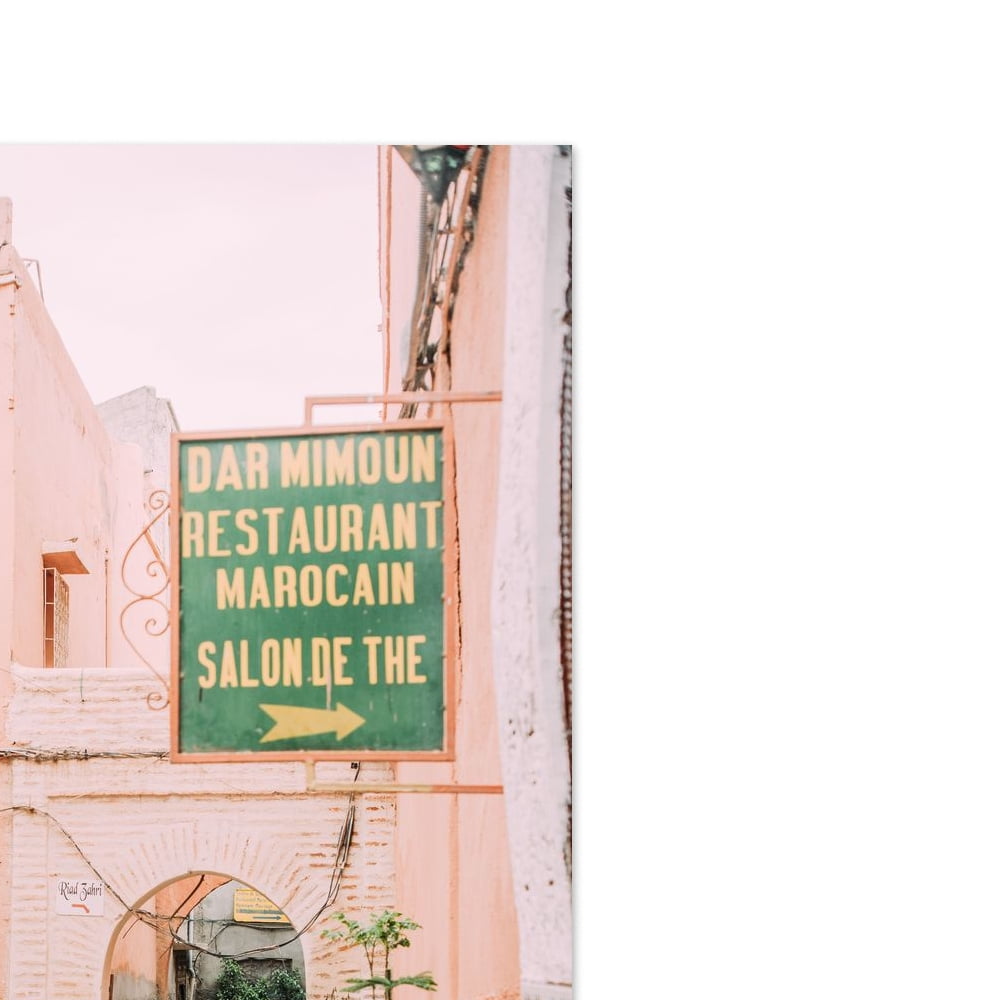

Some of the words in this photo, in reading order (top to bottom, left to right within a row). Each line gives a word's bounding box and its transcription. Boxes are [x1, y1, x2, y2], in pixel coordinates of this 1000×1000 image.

[187, 442, 269, 493] DAR
[280, 434, 436, 488] MIMOUN
[181, 501, 442, 558] RESTAURANT
[216, 561, 415, 610] MAROCAIN
[197, 637, 303, 689] SALON
[311, 636, 354, 686] DE
[362, 634, 427, 685] THE
[58, 881, 79, 901] Riad
[79, 882, 103, 902] Zahri
